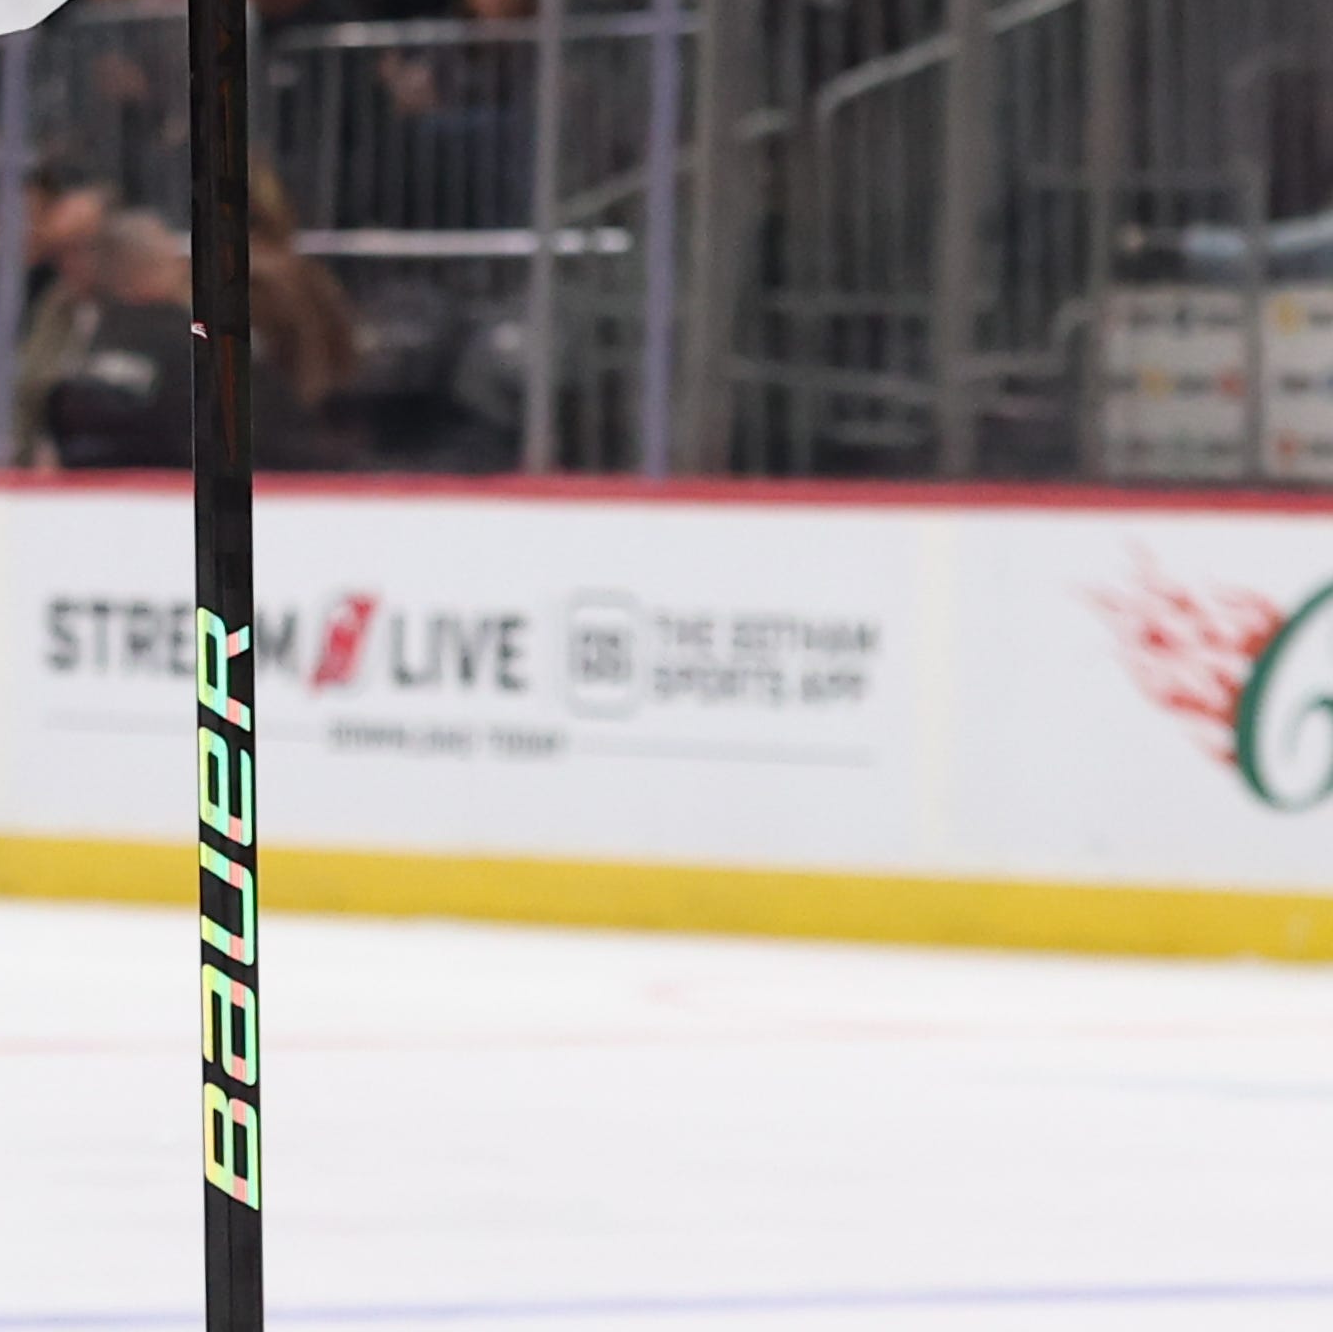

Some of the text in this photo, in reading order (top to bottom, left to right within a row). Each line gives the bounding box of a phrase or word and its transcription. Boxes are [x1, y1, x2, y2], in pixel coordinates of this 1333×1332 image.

[45, 595, 529, 691] STREM LIVE
[196, 607, 260, 1211] BAUER
